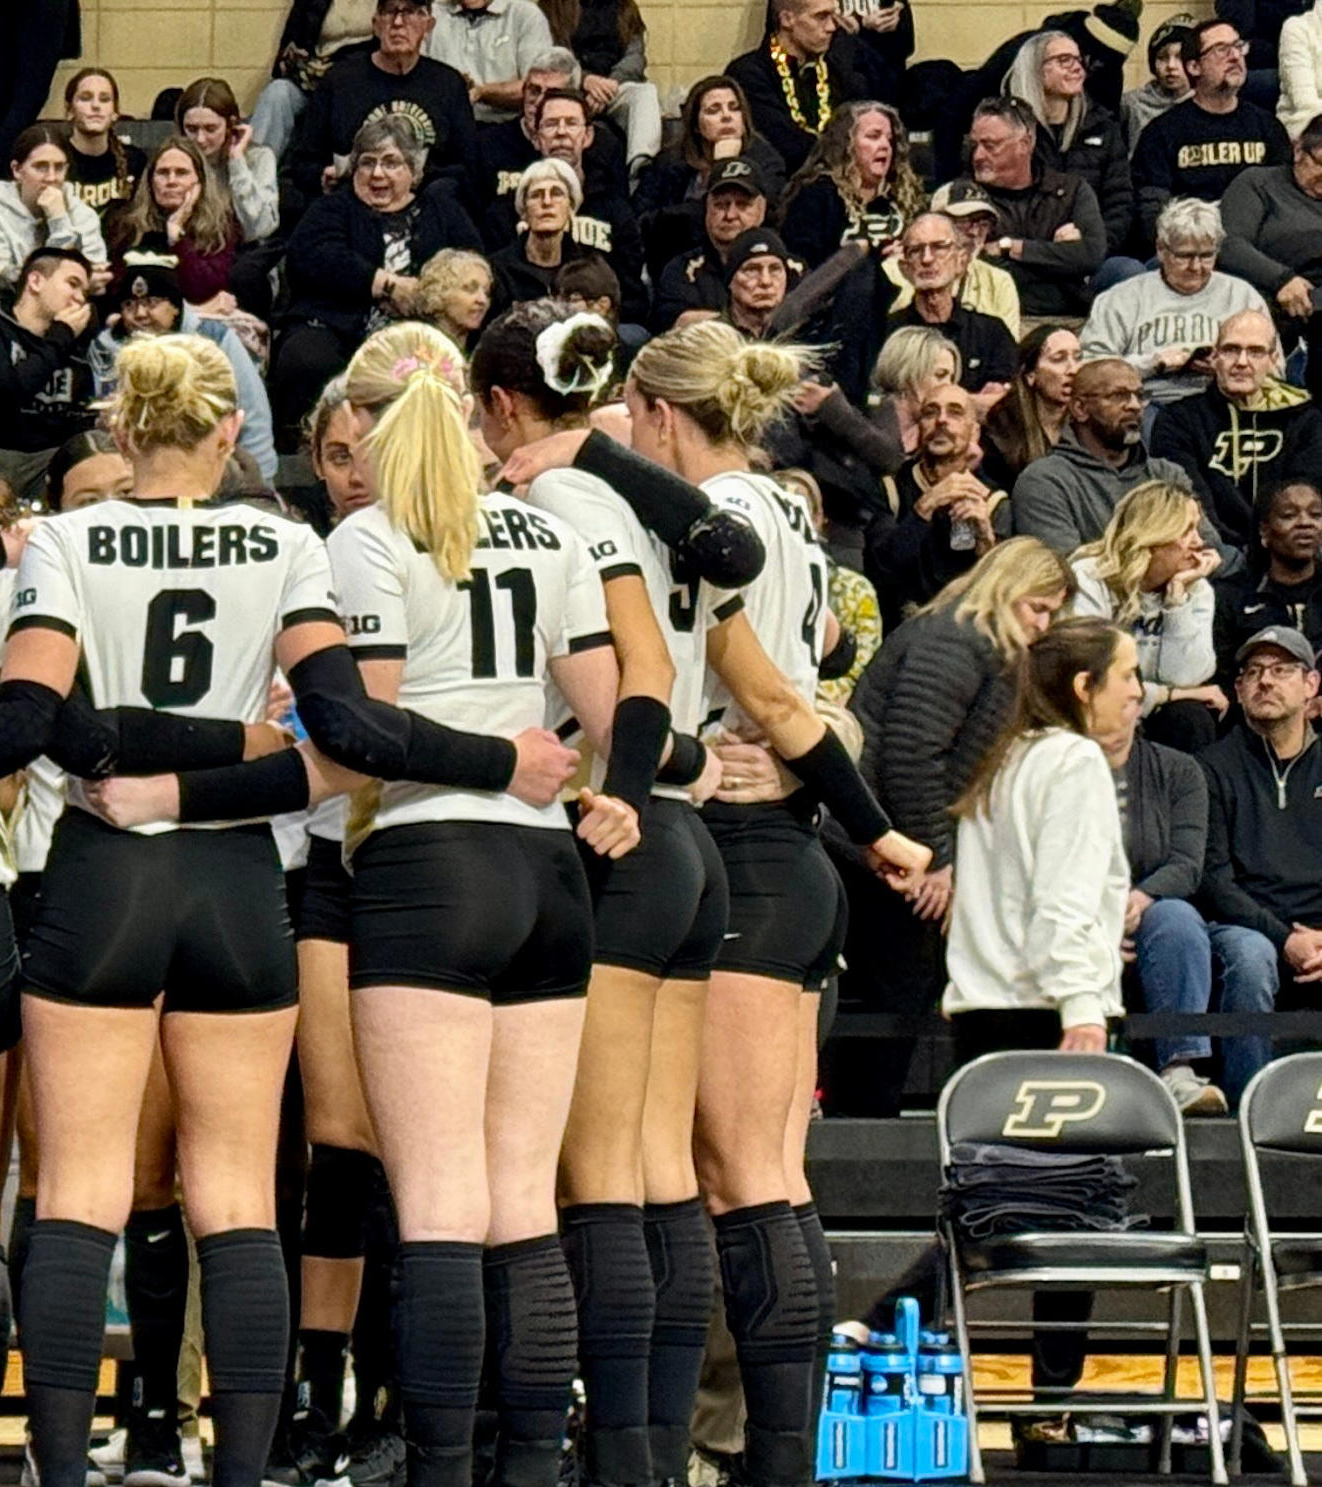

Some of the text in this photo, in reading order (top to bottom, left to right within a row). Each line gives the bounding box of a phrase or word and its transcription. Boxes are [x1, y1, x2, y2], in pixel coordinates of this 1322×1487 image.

[1243, 142, 1266, 164] UP
[1208, 429, 1284, 477] P
[88, 524, 279, 570] BOILERS
[140, 588, 217, 708] 6
[456, 566, 537, 680] 11
[1002, 1080, 1106, 1138] P
